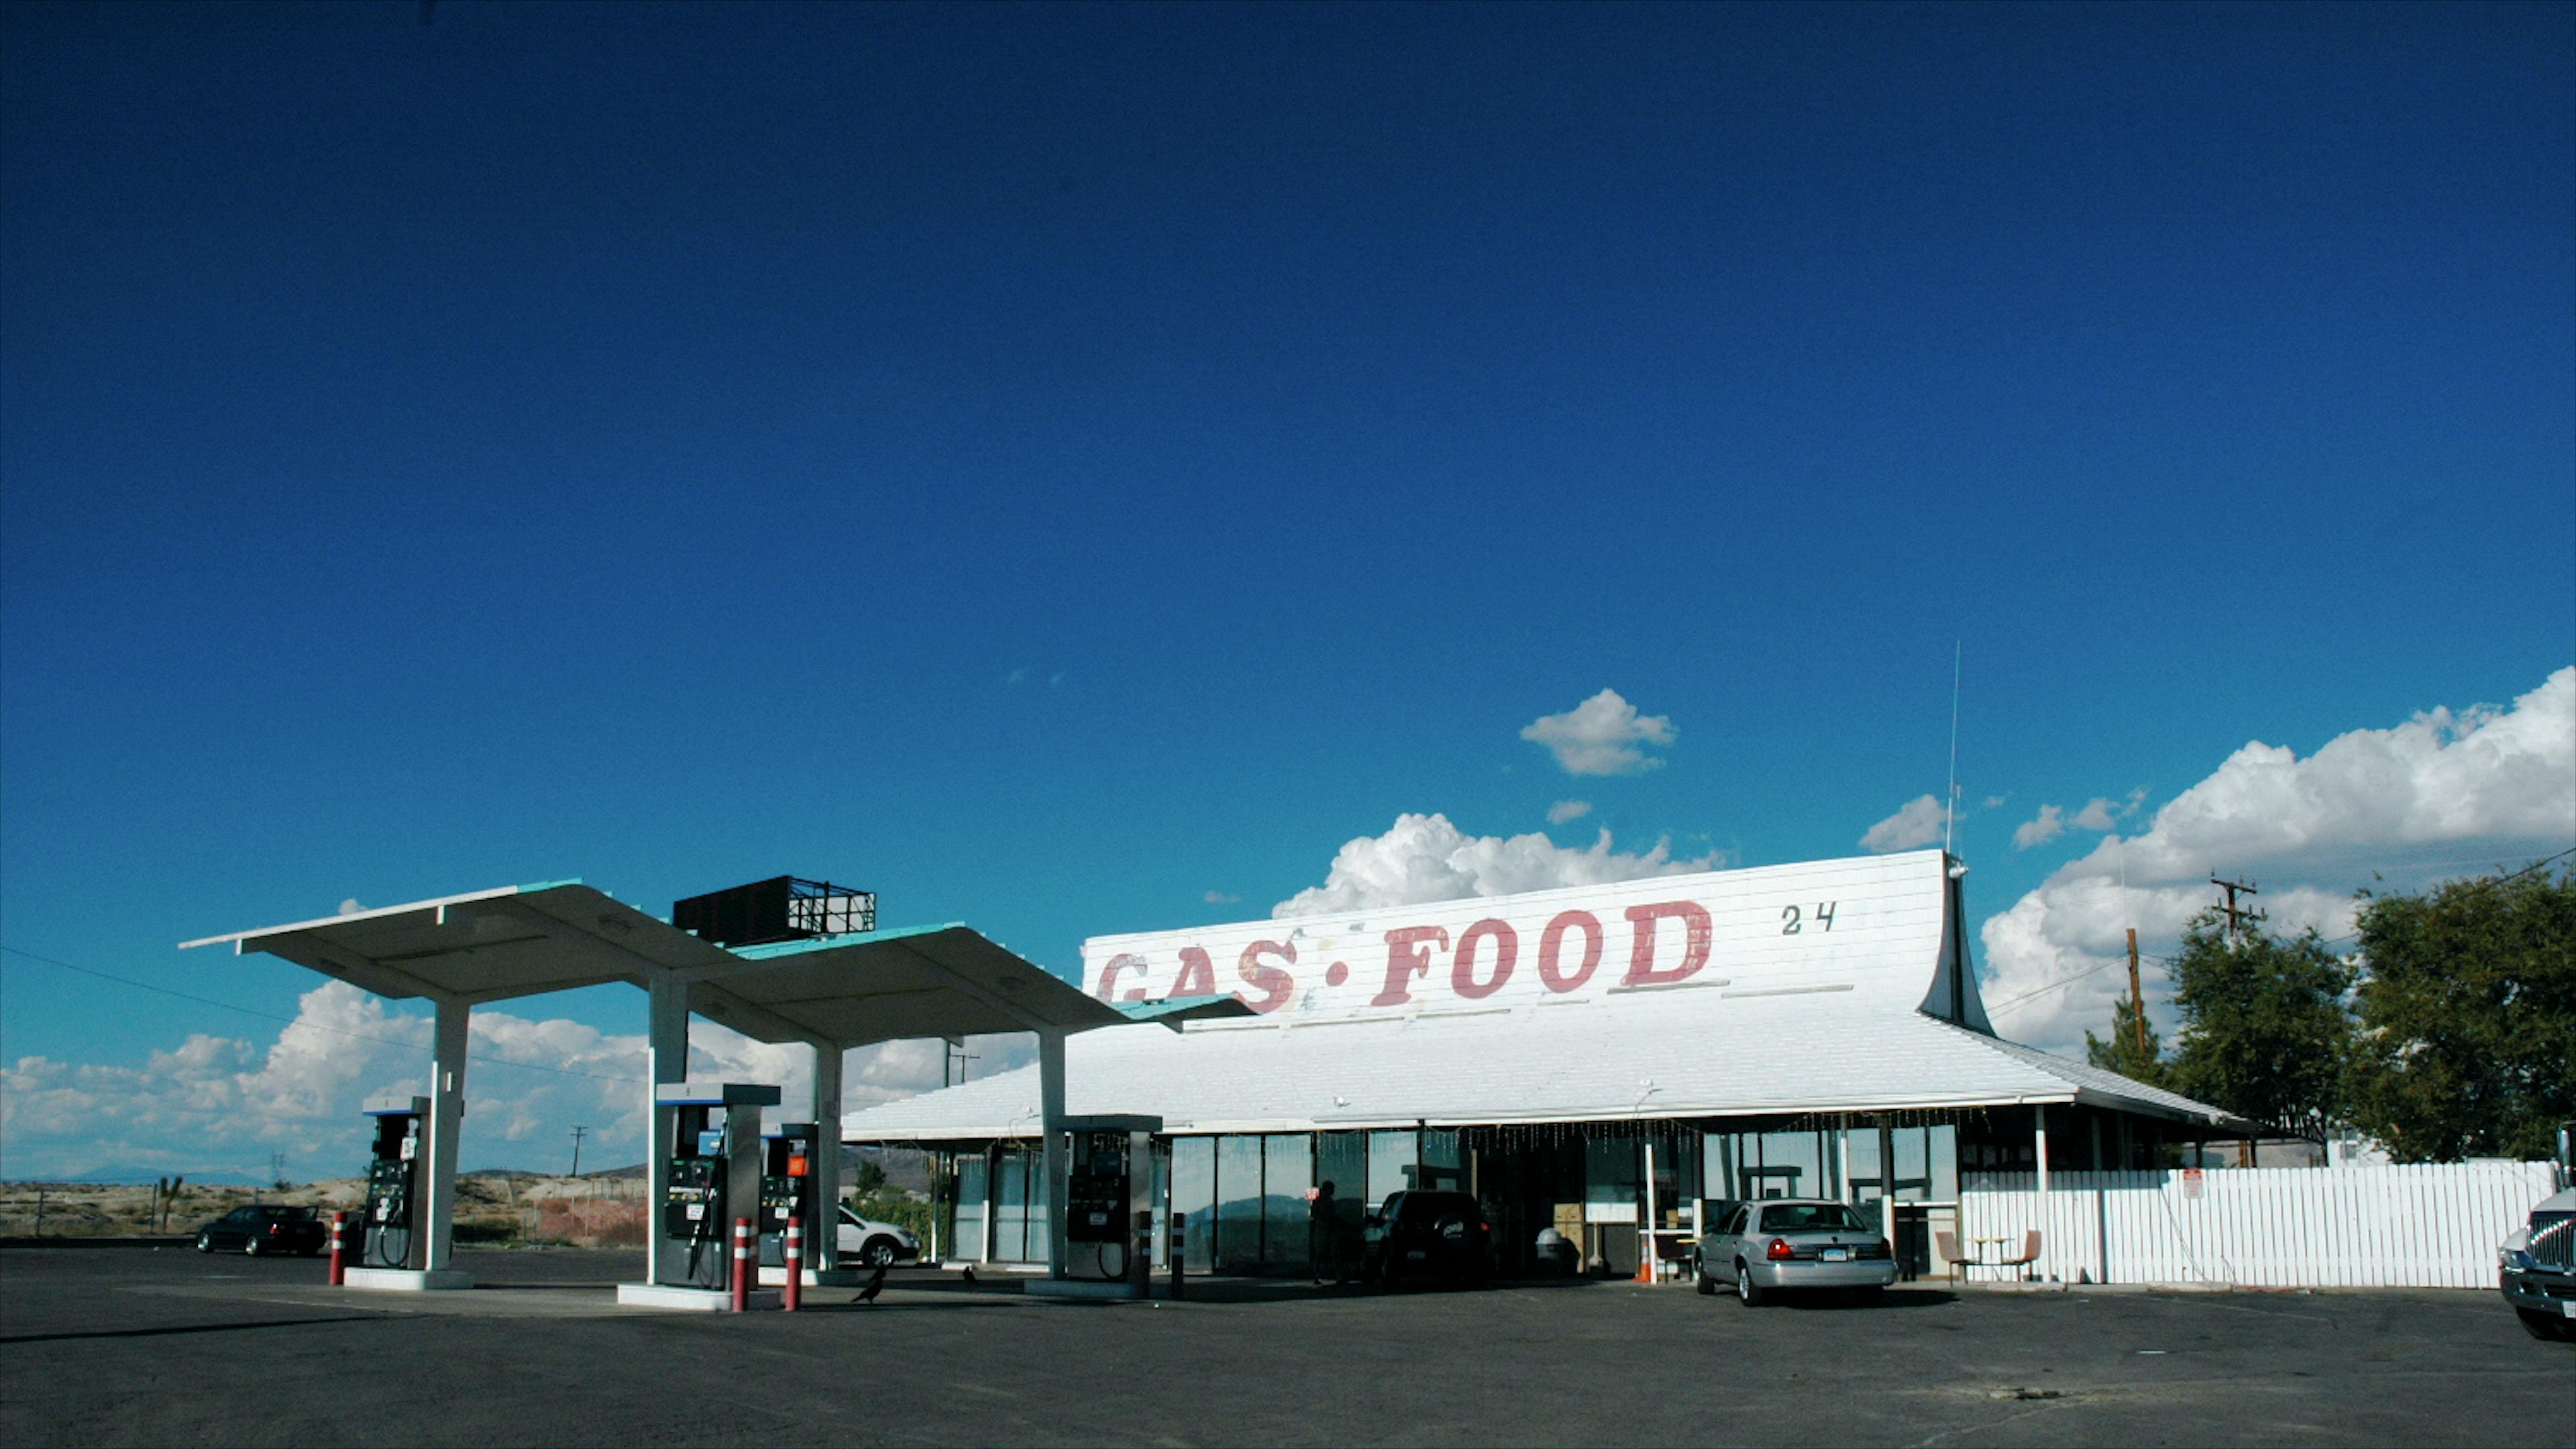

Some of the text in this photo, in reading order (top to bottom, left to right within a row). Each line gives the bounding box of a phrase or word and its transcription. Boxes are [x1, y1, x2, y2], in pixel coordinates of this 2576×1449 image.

[1782, 900, 1837, 936] 24
[1097, 900, 1713, 1014] GAS FOOD
